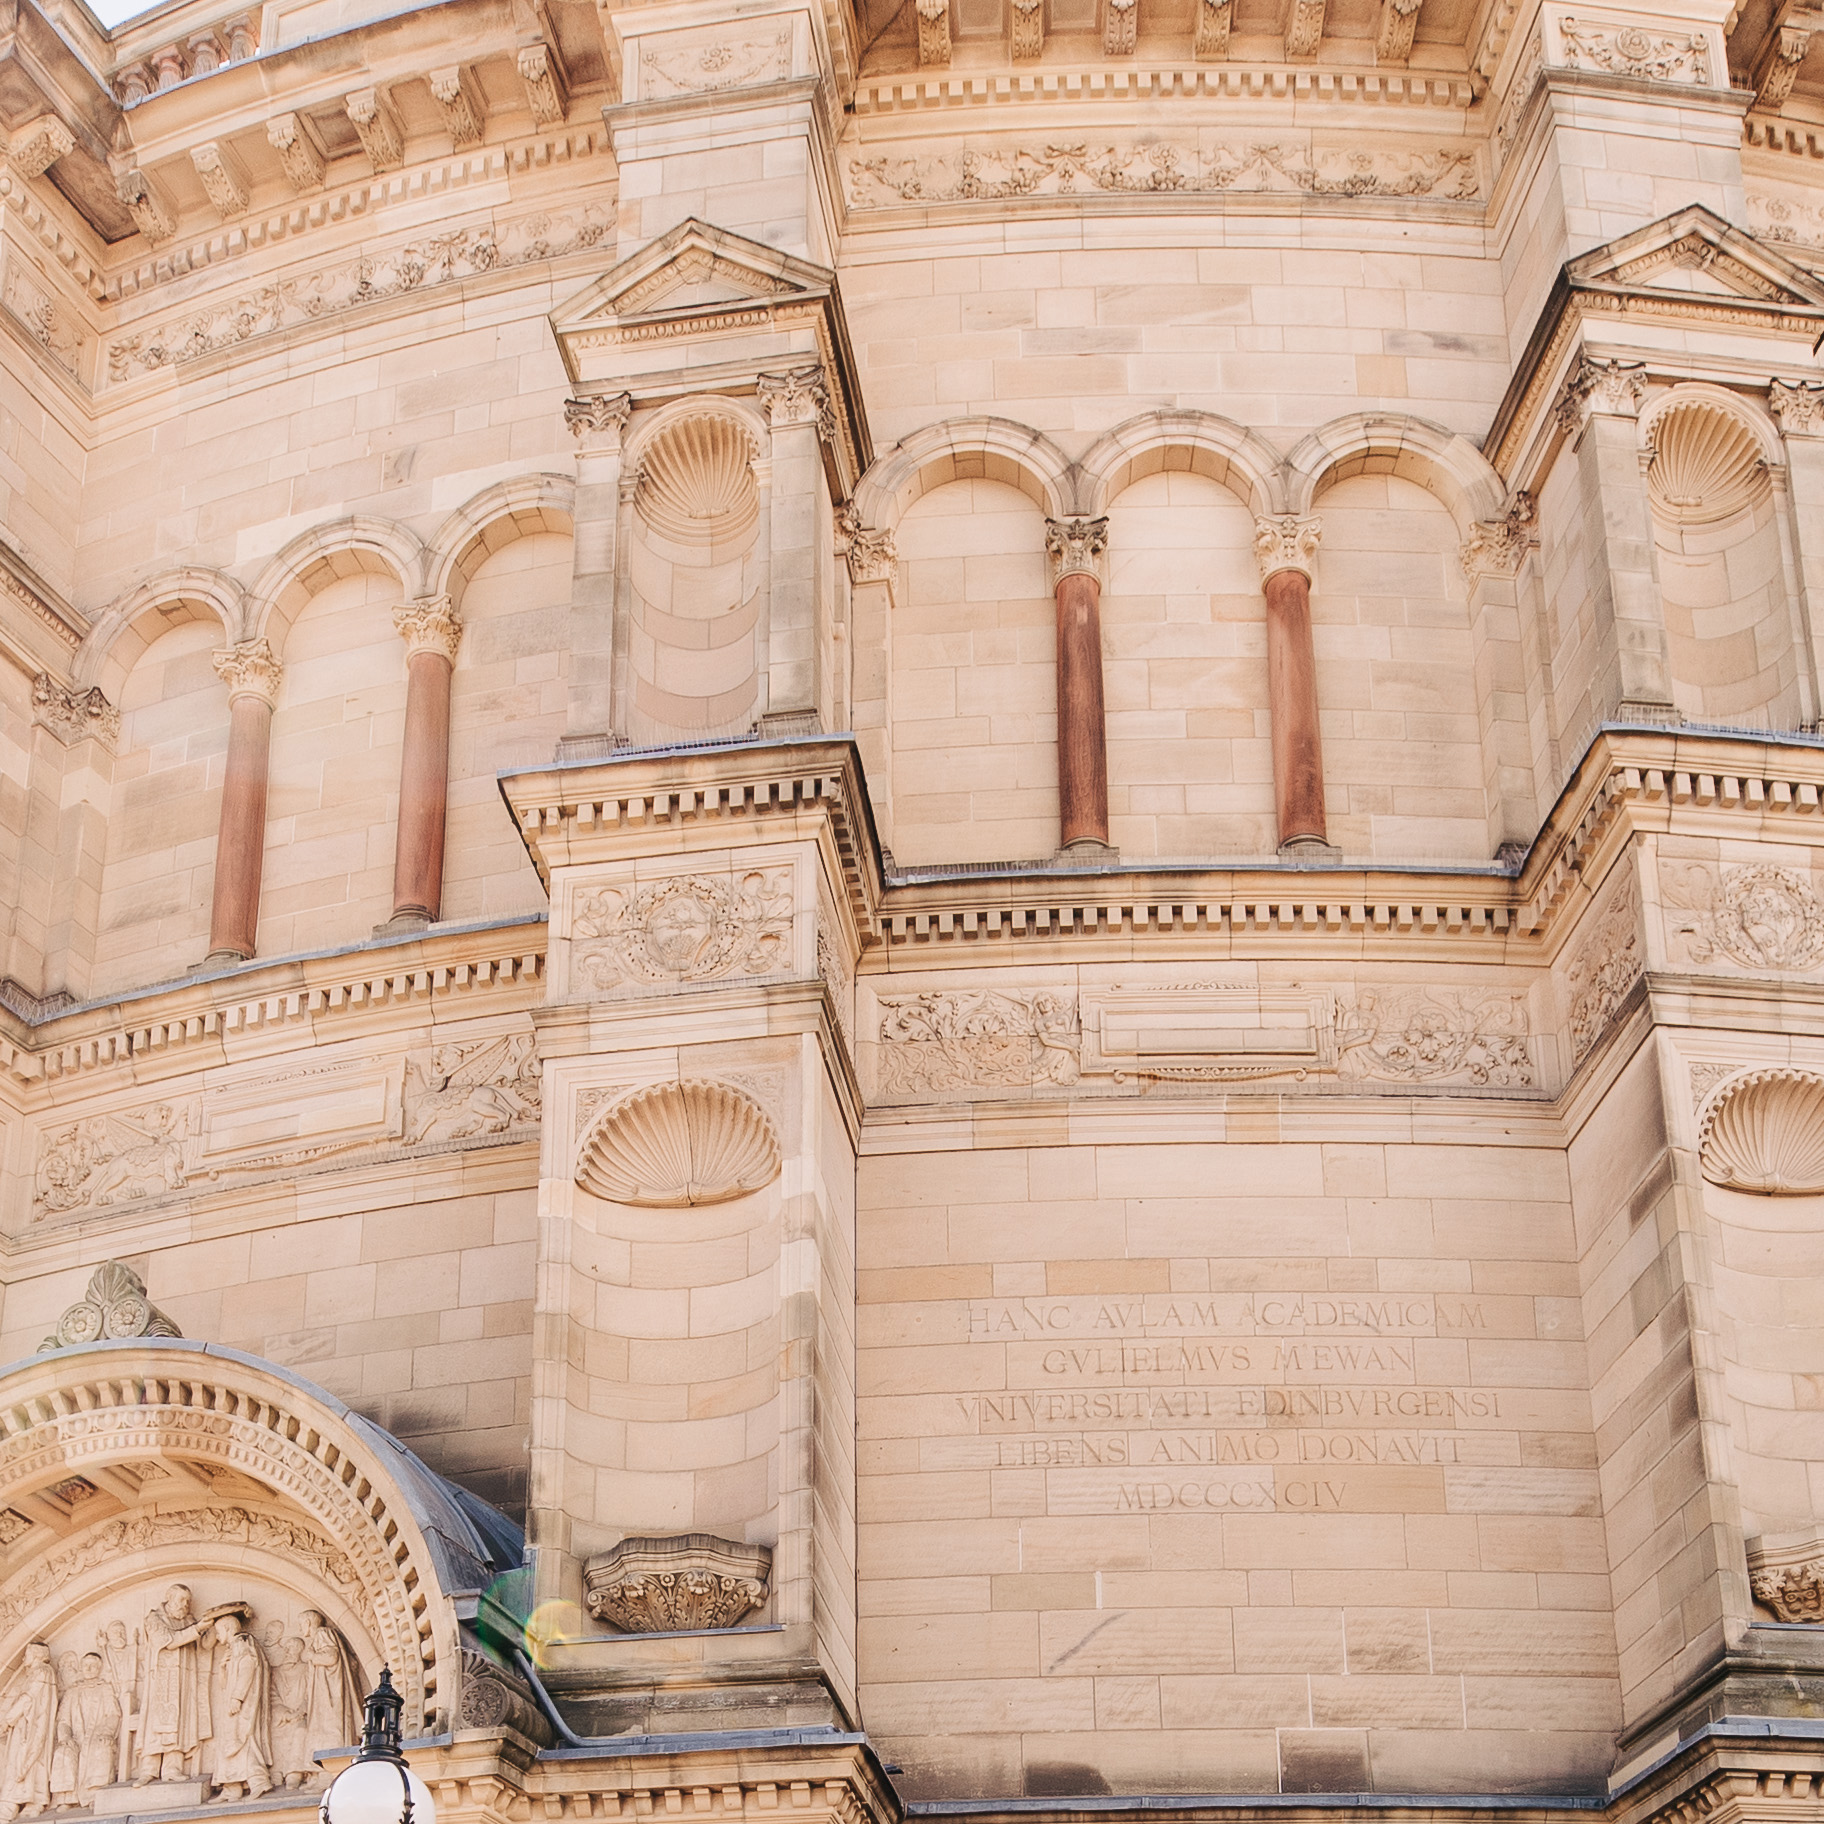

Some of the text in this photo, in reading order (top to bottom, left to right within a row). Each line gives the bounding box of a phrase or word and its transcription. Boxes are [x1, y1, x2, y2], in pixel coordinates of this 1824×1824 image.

[968, 1300, 1489, 1333] HANC AVLAM ACADEMICAM
[1042, 1345, 1252, 1374] GVLIELMVS
[955, 1389, 1502, 1422] VNIVERSITATI EDINBVRGENSI
[994, 1434, 1466, 1467] LIBENS ANIMO DONAVIT
[1114, 1480, 1347, 1510] MDCCCXCIV
